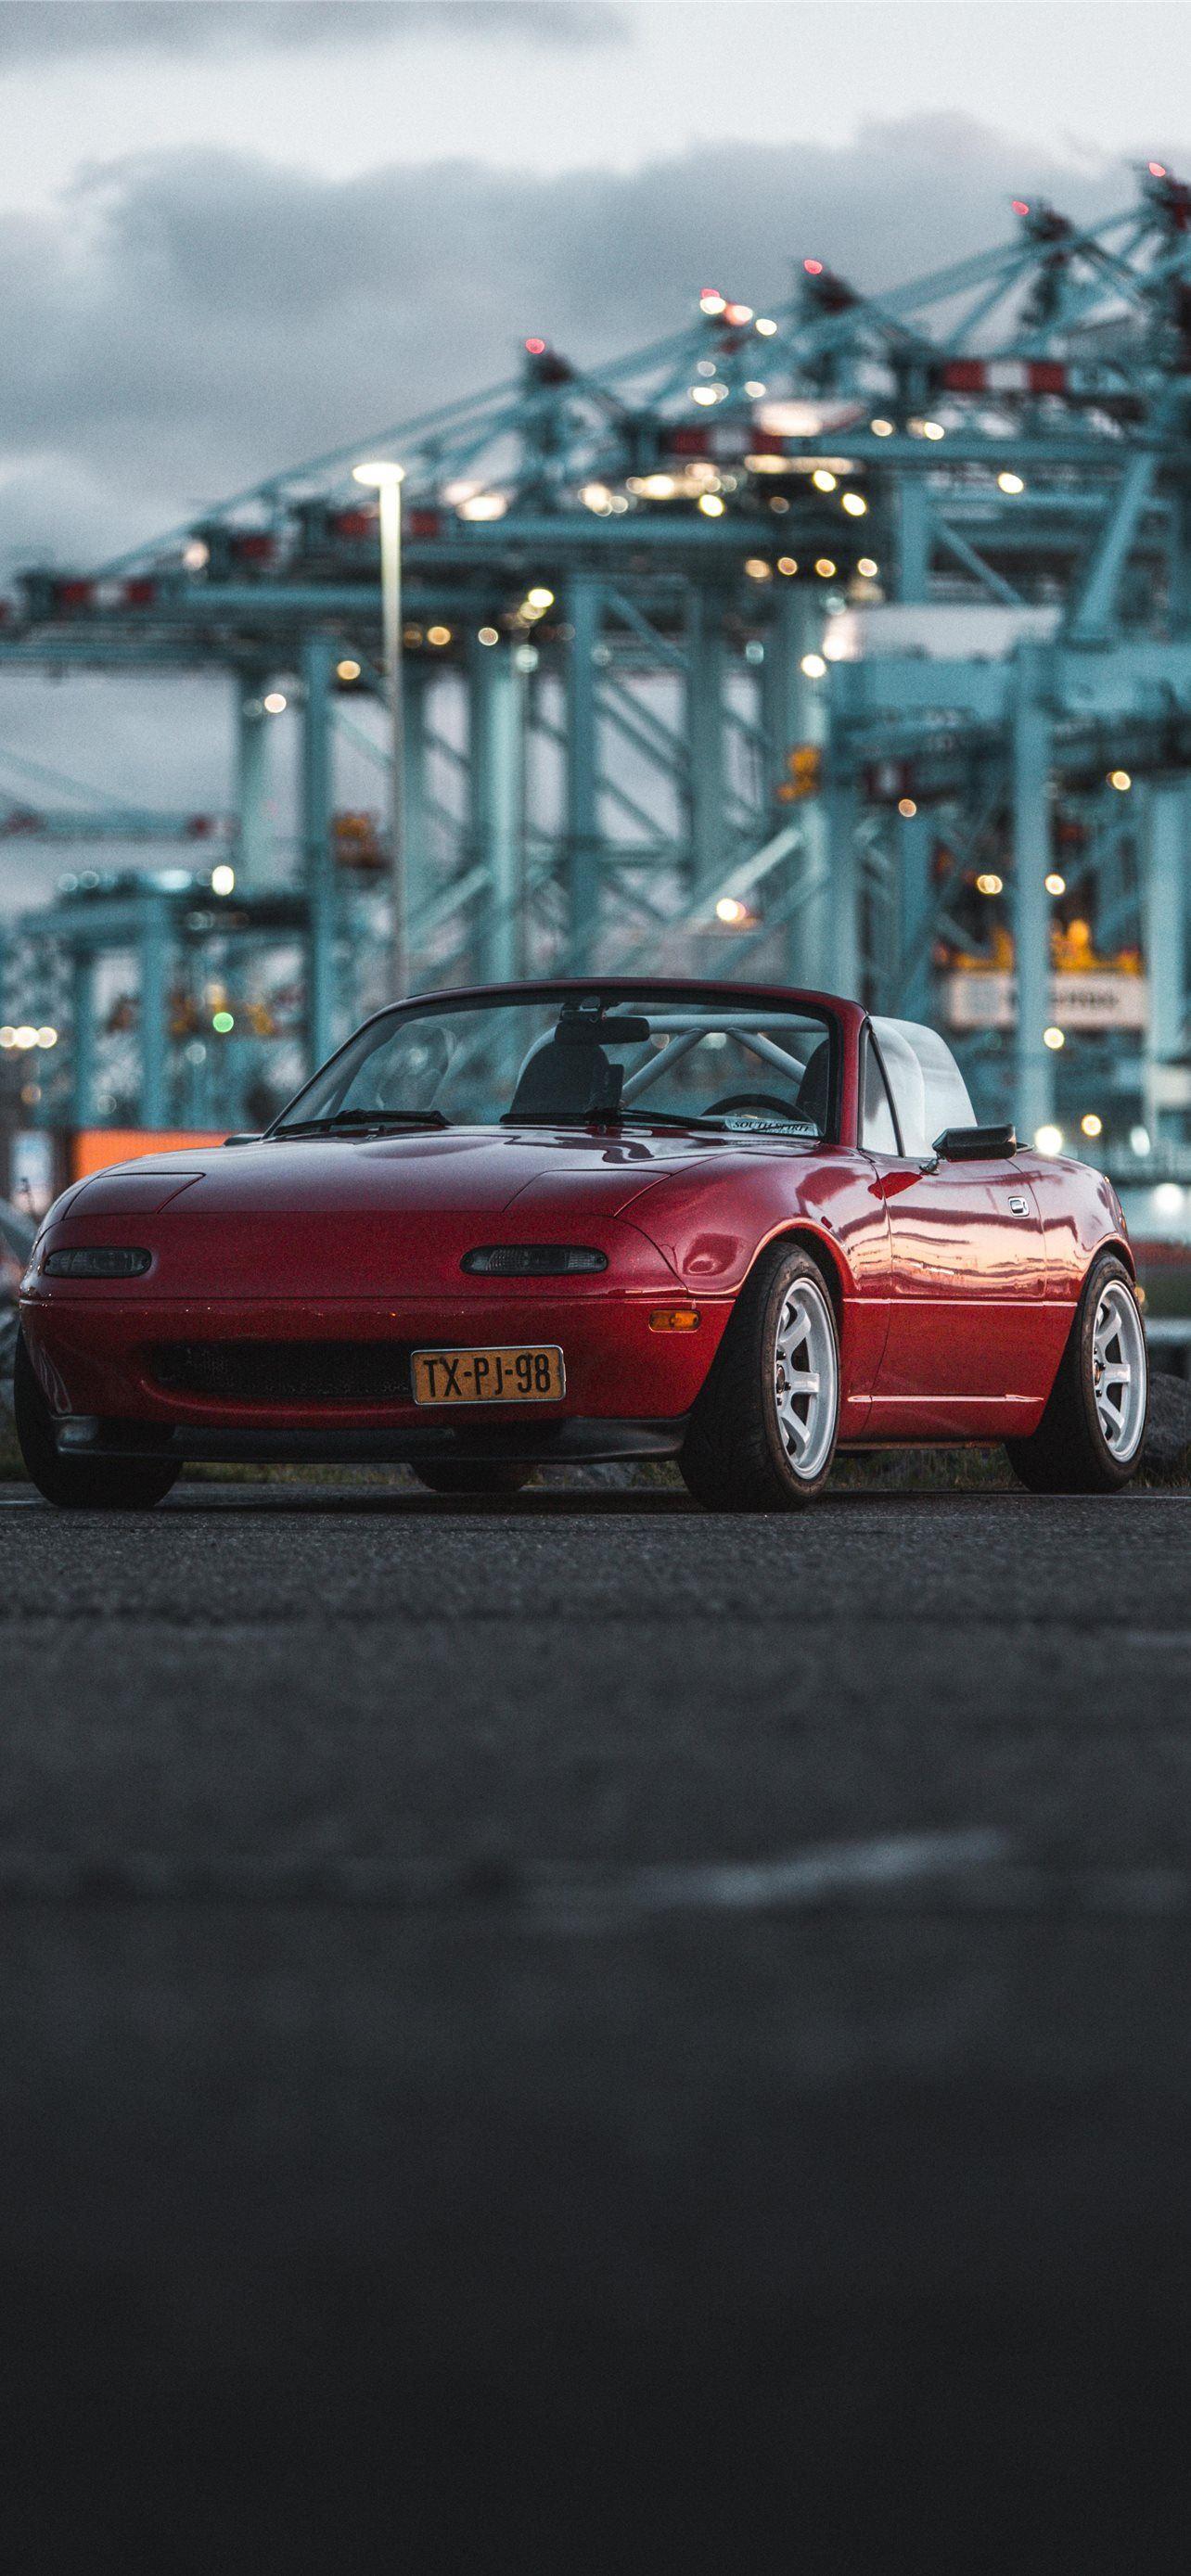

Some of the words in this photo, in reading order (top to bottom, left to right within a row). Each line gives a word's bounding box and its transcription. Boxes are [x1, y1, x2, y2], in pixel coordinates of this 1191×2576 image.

[732, 1120, 774, 1130] SOUTH
[774, 1122, 810, 1132] SPIRIT
[423, 1354, 551, 1397] TX-PJ-98
